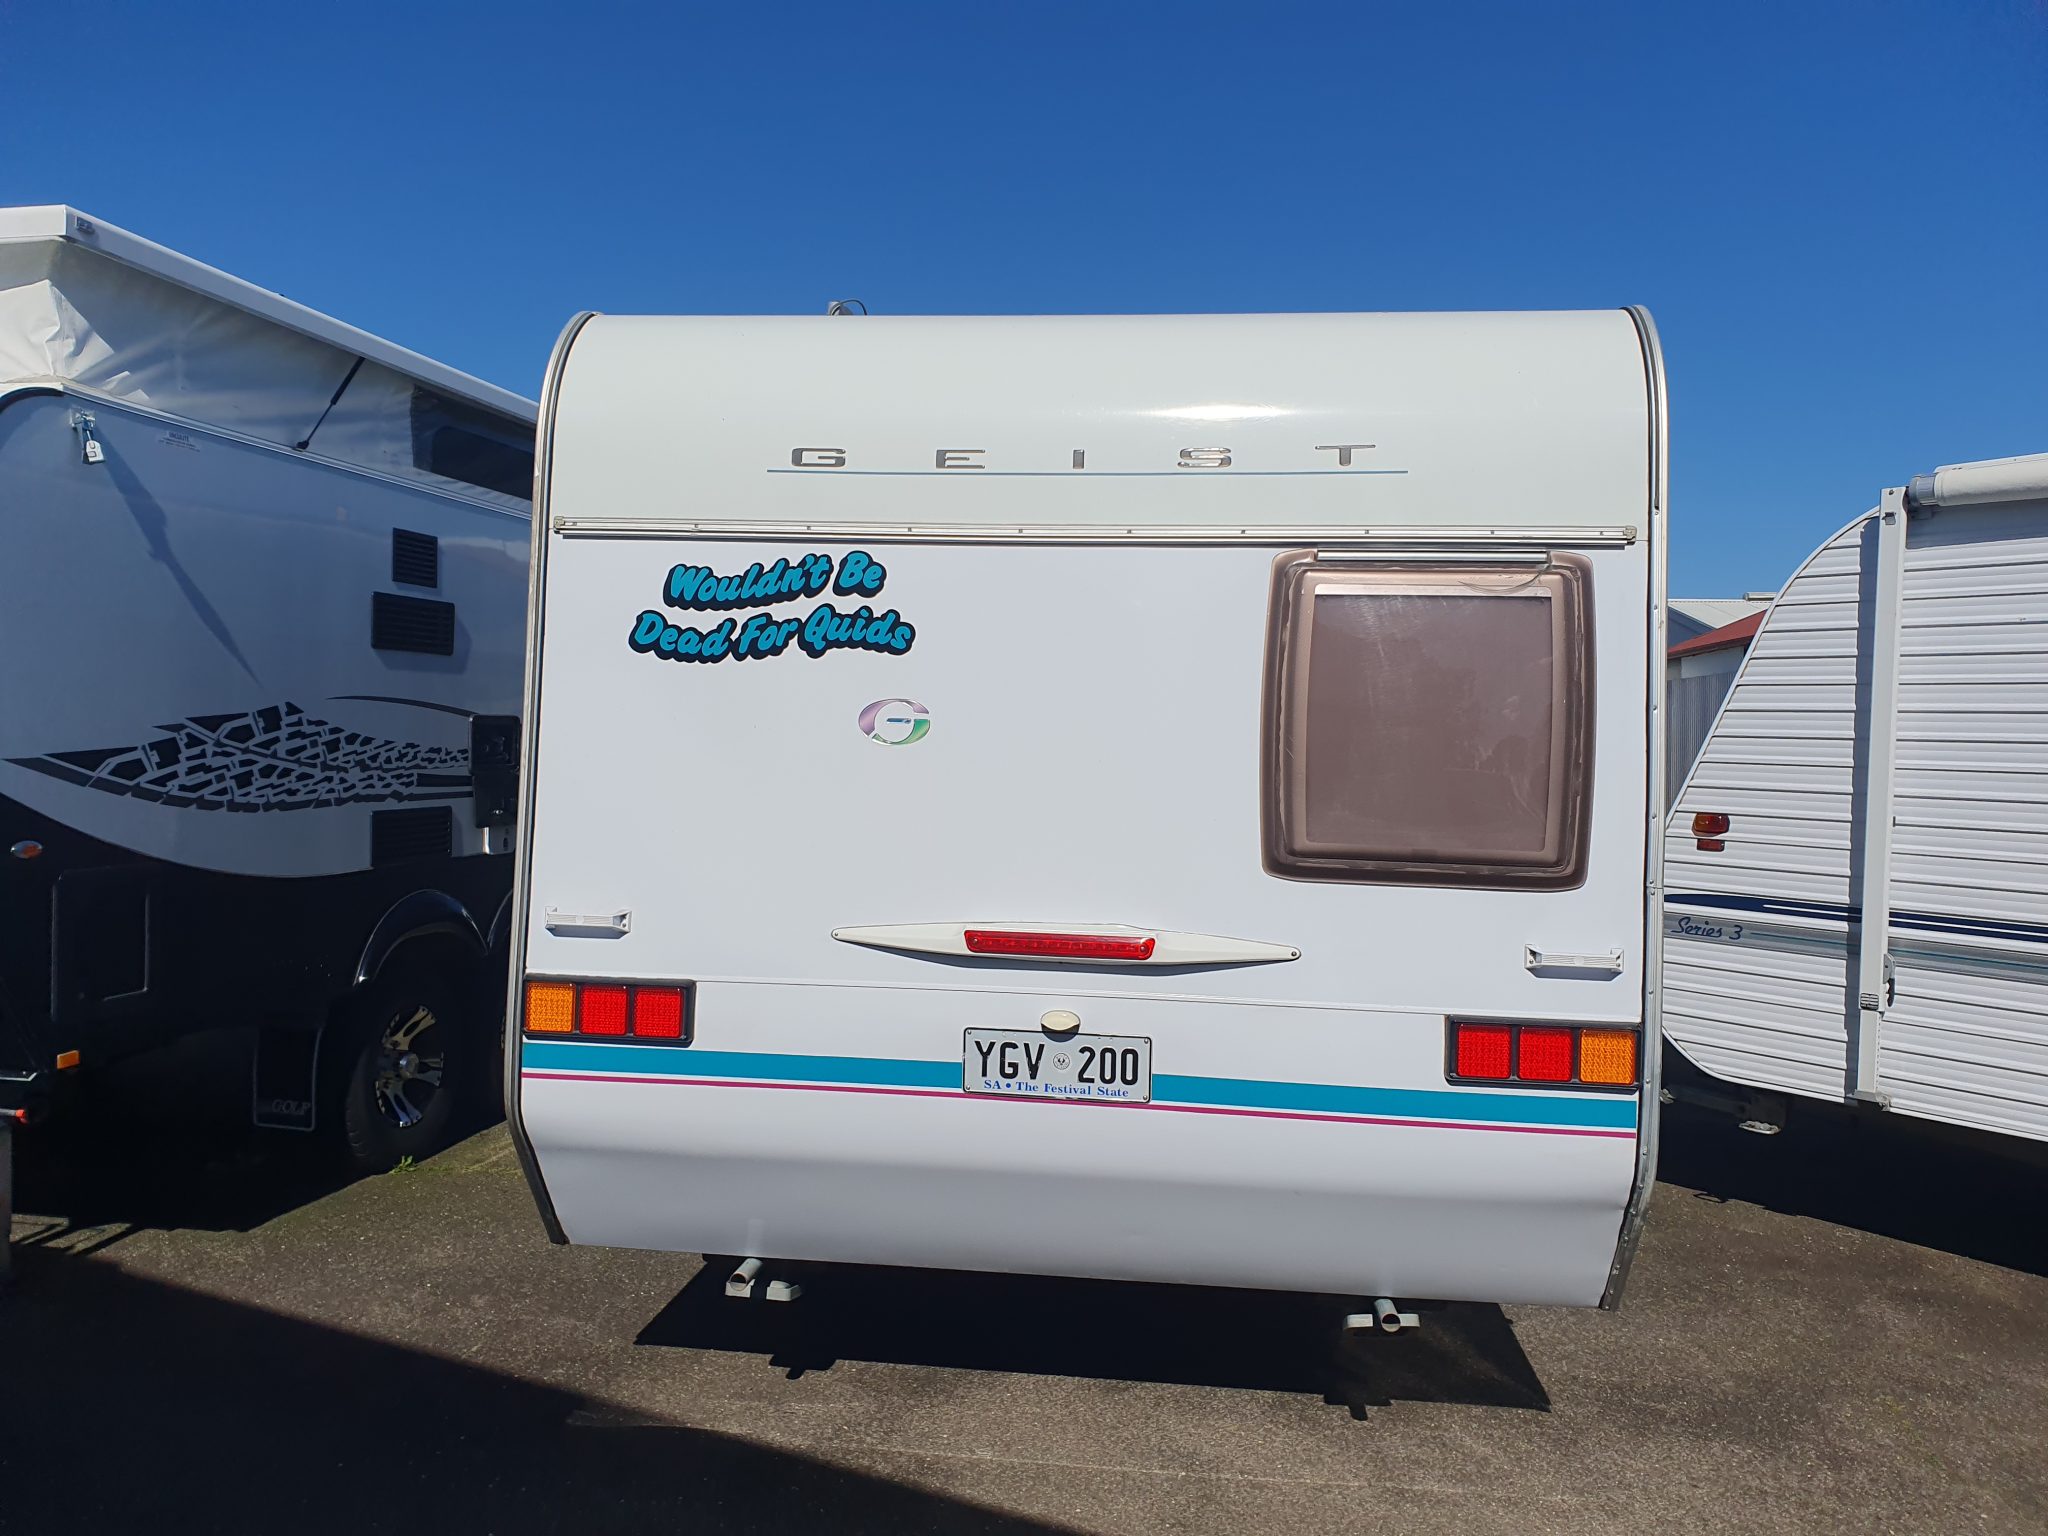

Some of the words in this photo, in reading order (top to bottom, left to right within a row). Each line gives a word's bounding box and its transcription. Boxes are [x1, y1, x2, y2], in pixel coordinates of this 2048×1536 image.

[791, 443, 1376, 470] GEIST
[665, 553, 831, 607] Wouldn't
[835, 551, 885, 594] Be
[631, 611, 735, 660] Dead
[736, 615, 800, 658] For
[801, 605, 914, 655] Quids
[1670, 916, 1723, 938] Series
[1728, 924, 1743, 940] 3
[974, 1040, 1045, 1080] YGV
[1077, 1045, 1139, 1086] 200
[984, 1079, 1002, 1090] SA
[1016, 1081, 1039, 1092] The
[1044, 1083, 1092, 1096] Festival
[1097, 1086, 1129, 1098] State
